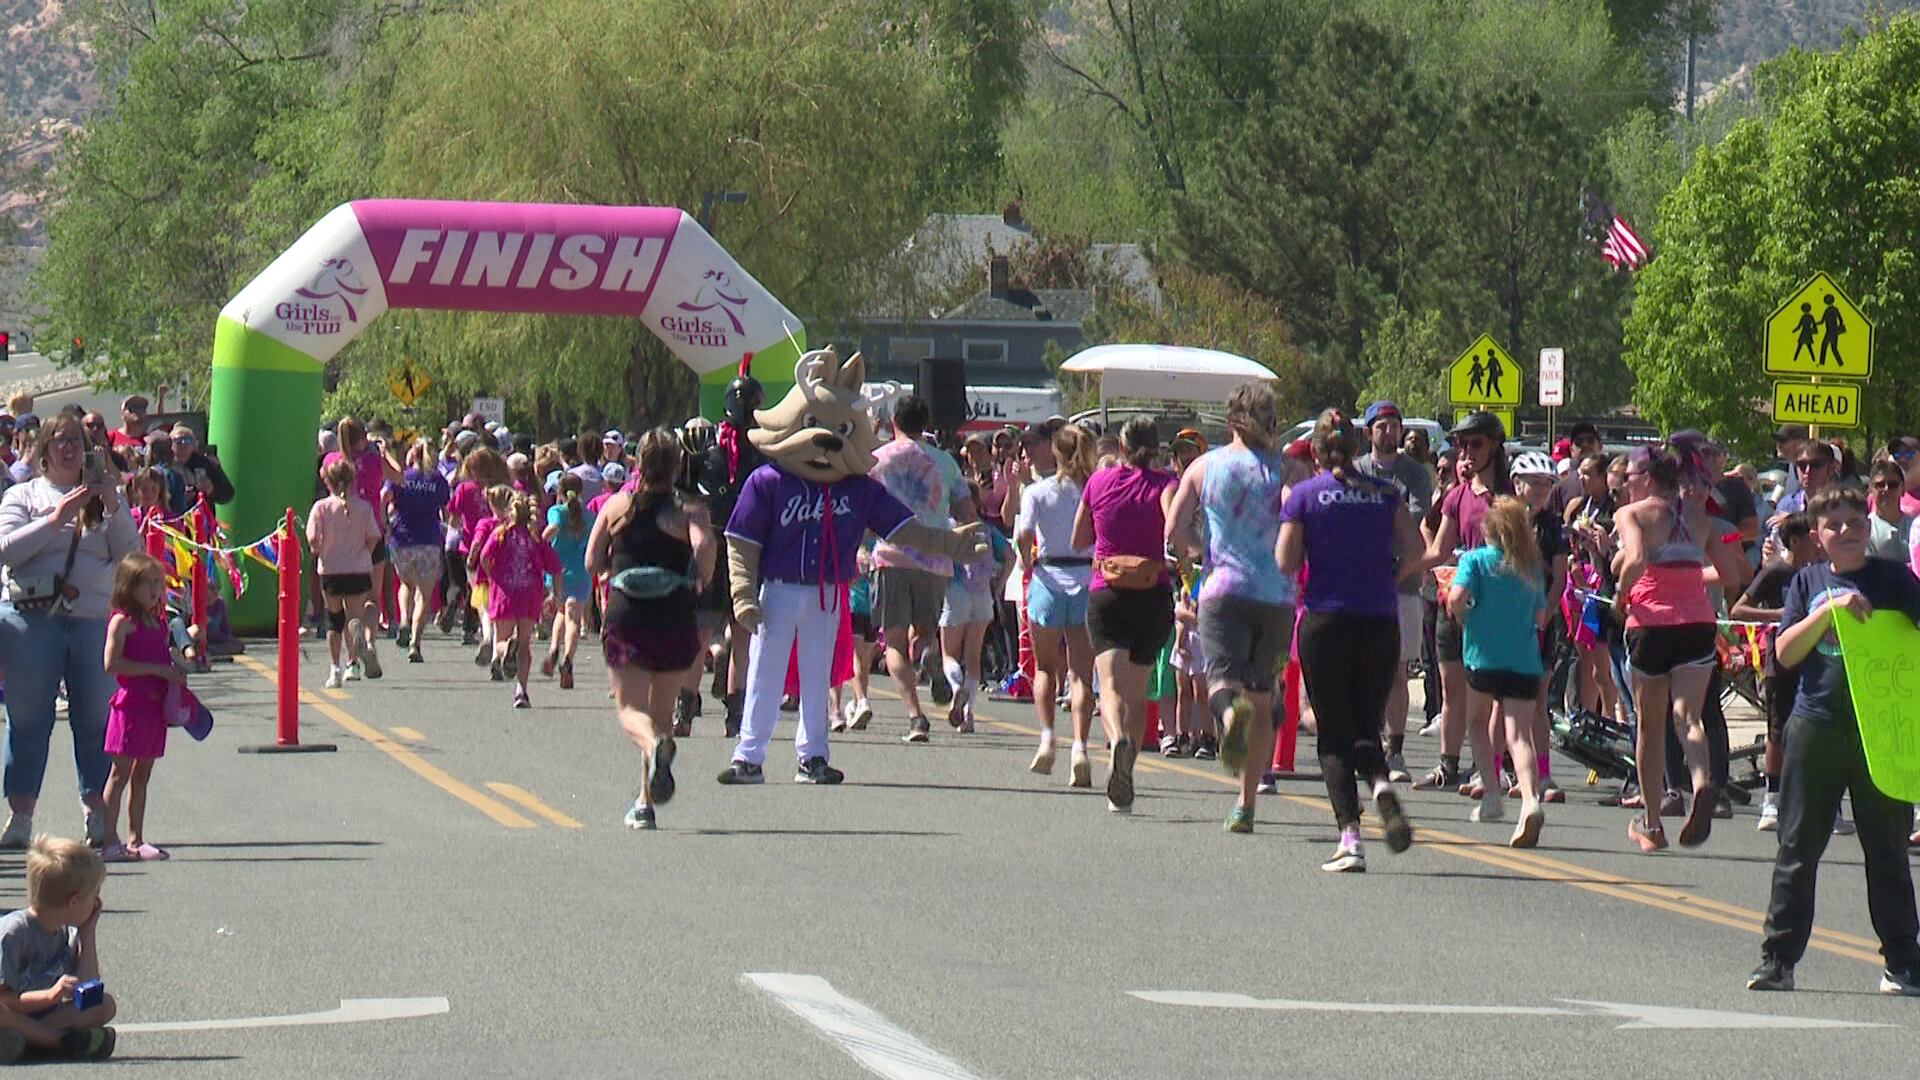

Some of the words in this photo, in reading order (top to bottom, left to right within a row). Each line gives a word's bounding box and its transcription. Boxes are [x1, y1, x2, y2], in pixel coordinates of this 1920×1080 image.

[388, 228, 666, 293] FINISH
[275, 302, 329, 320] Girls
[303, 320, 341, 335] run
[660, 315, 713, 333] Girls
[688, 334, 729, 348] run
[479, 402, 498, 412] END
[1783, 392, 1849, 416] AHEAD
[1318, 489, 1384, 505] COACH
